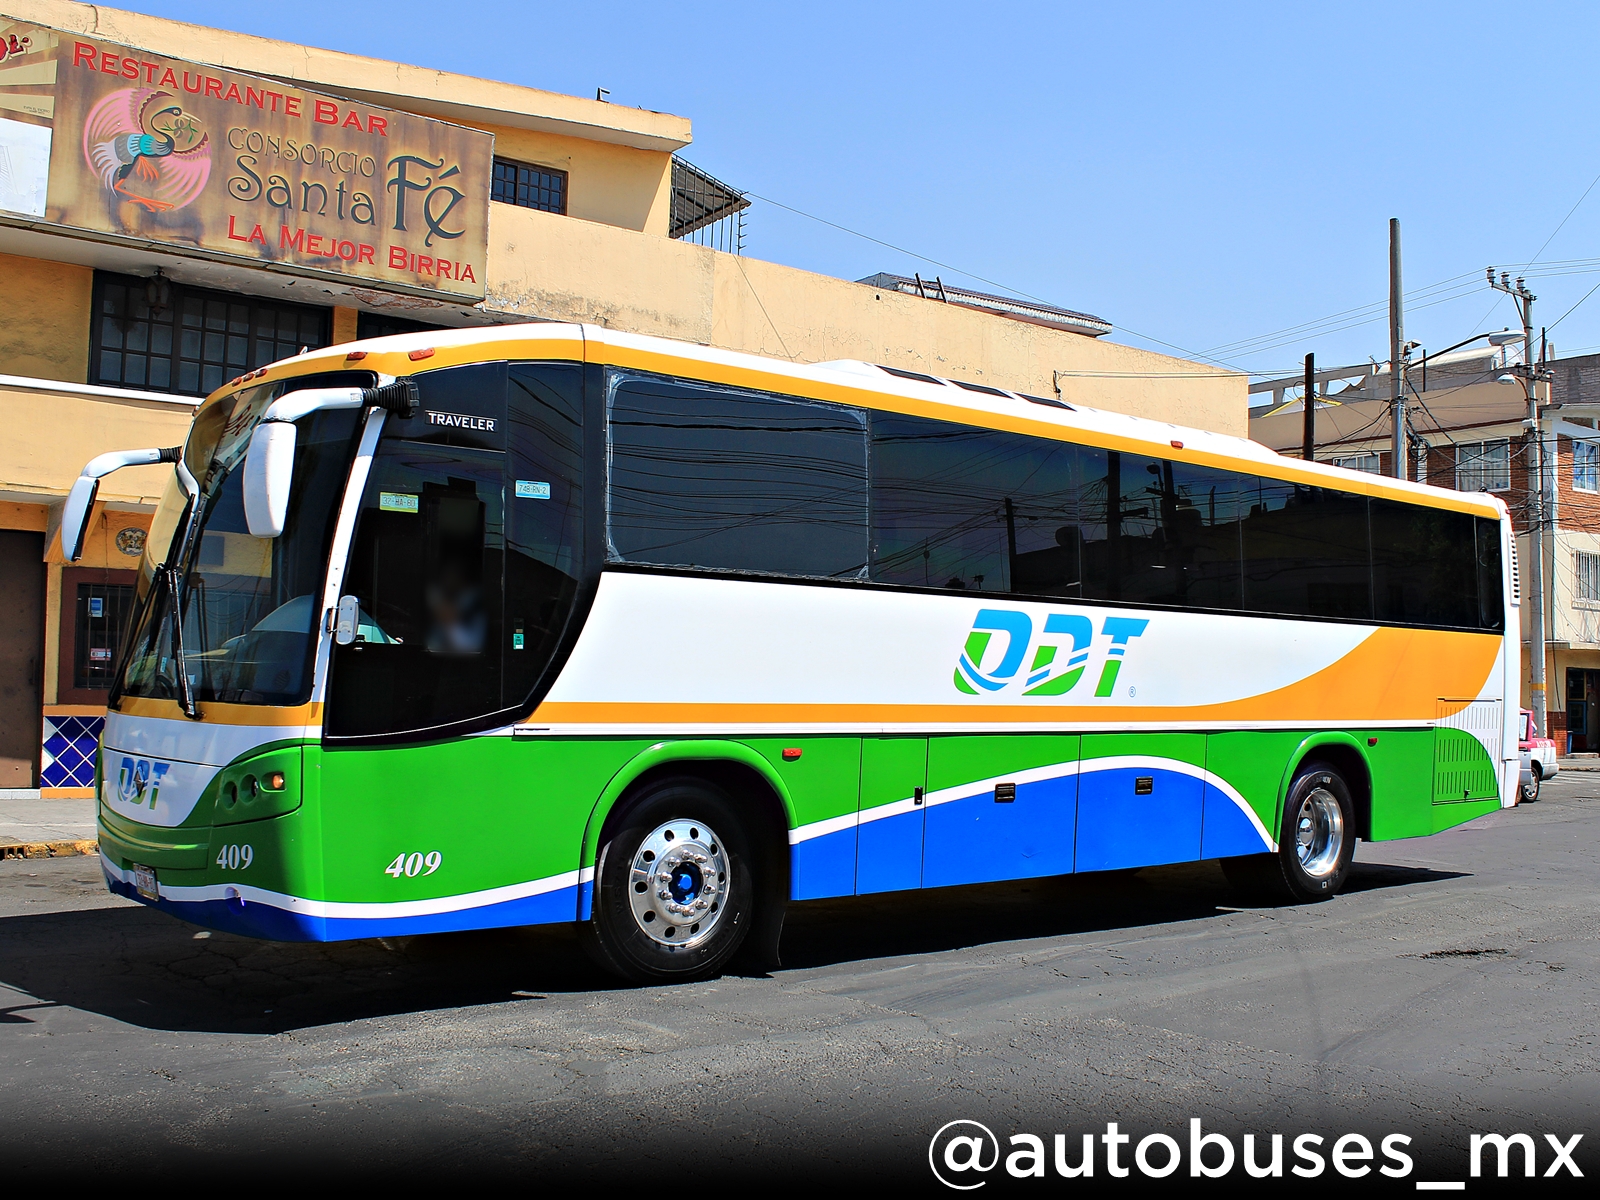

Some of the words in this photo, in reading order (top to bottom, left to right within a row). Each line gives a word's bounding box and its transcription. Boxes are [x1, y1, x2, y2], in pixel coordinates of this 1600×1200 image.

[73, 41, 302, 118] RESTAURANTE
[314, 99, 388, 137] BAR
[227, 127, 376, 177] CONSORCIO
[227, 155, 376, 226] Santa
[387, 155, 466, 247] Fé
[227, 214, 267, 245] LA
[279, 225, 375, 265] MEJOR
[388, 245, 477, 284] BIRRIA
[428, 412, 495, 432] TRAVELER
[216, 844, 254, 870] 409
[384, 851, 443, 878] 409
